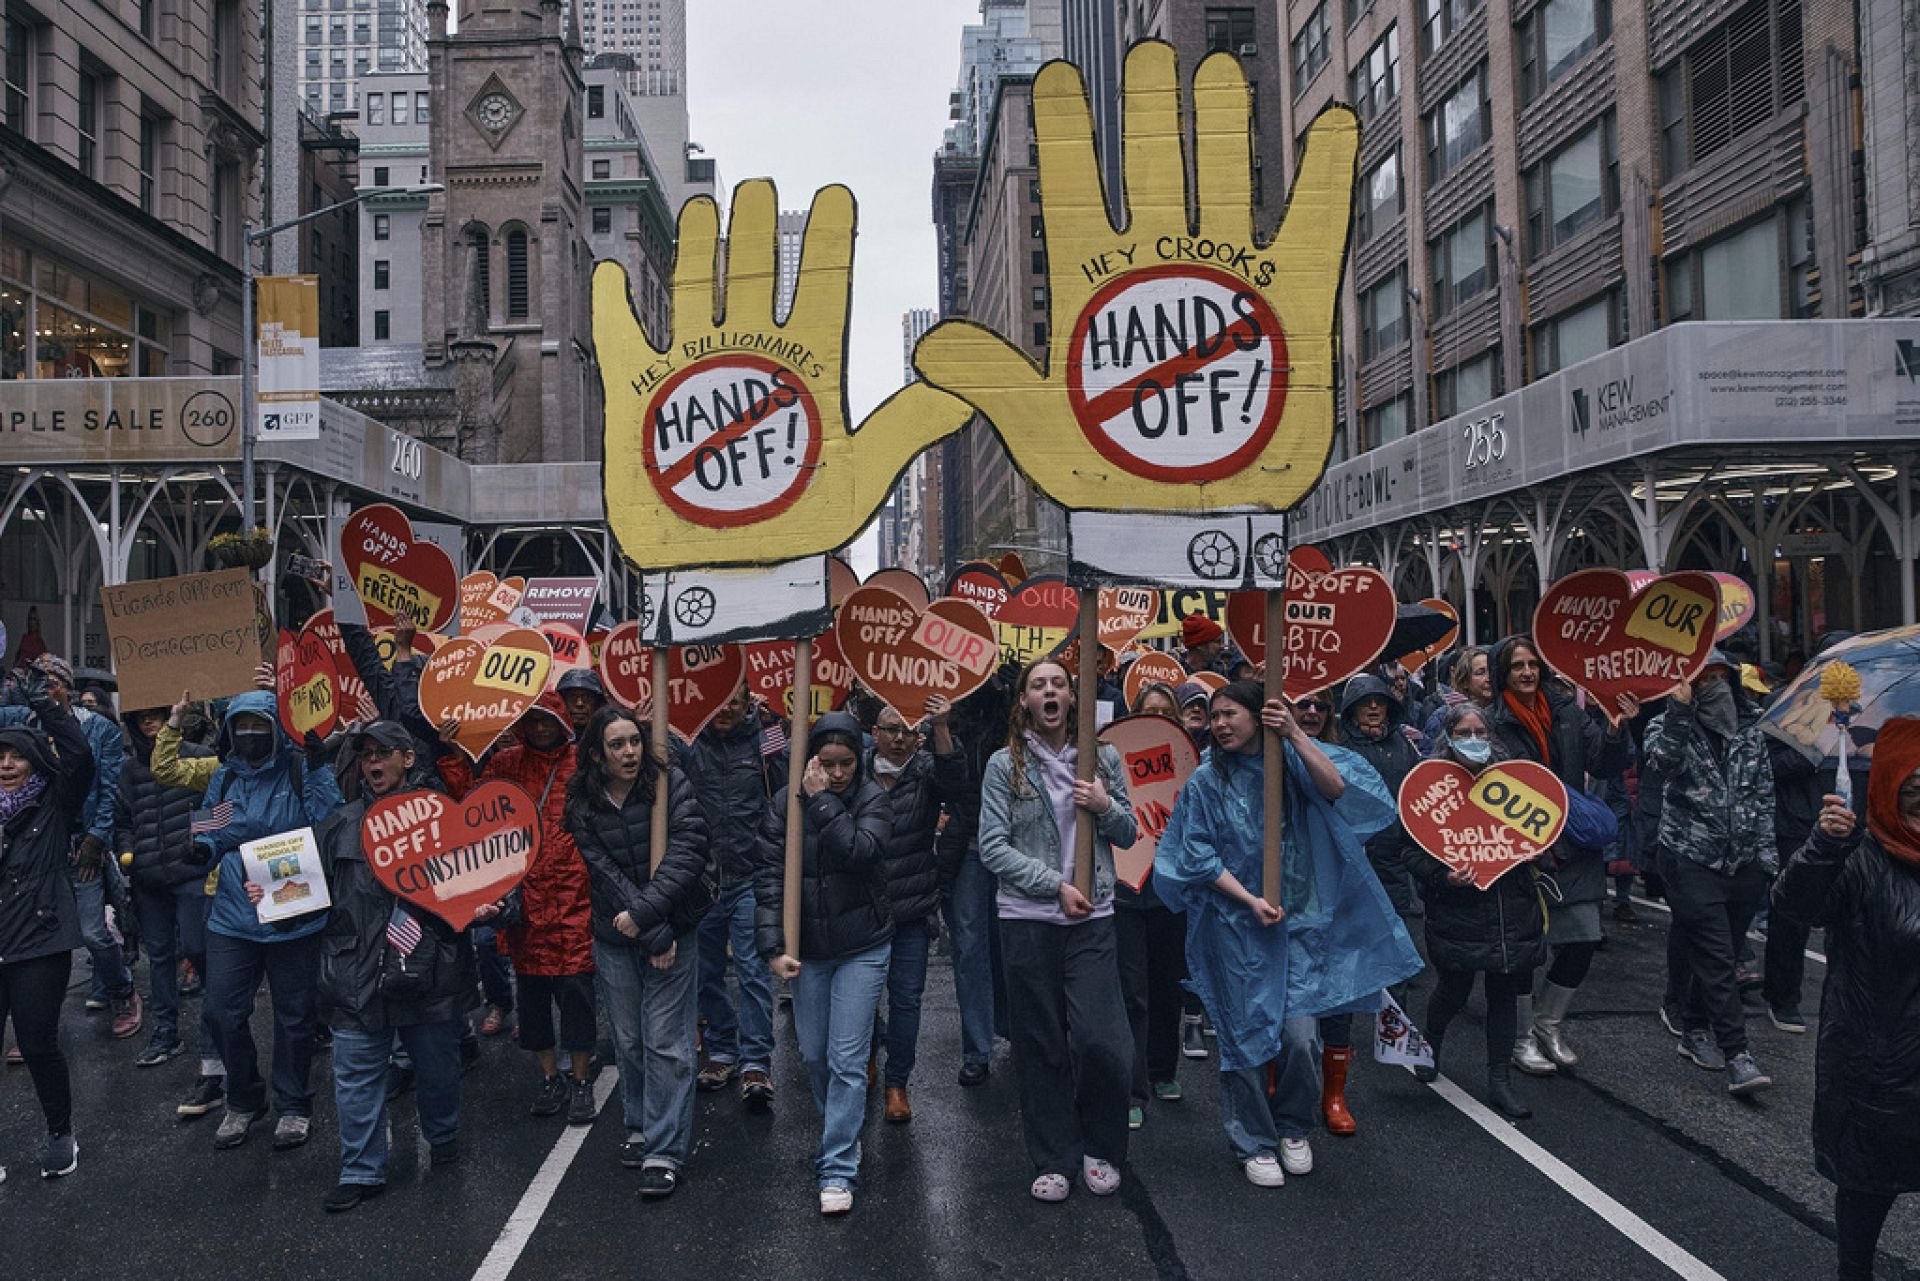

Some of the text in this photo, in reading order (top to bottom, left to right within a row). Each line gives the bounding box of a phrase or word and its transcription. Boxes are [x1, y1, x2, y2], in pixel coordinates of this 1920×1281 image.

[1081, 243, 1136, 284] HEY
[1089, 291, 1263, 370] HANDS
[631, 331, 824, 397] HEY BILLIONAIRES
[655, 366, 800, 451] HANDS
[1132, 358, 1264, 438] OFF!
[1597, 375, 1634, 415] KEW
[84, 408, 164, 430] SALE
[189, 410, 228, 427] 260
[1599, 395, 1671, 432] MANAGEMENT
[391, 434, 421, 480] 260
[693, 412, 799, 491] OFF!
[1463, 411, 1505, 469] 255
[360, 517, 408, 557] HANDS
[363, 538, 398, 565] OFF!
[108, 583, 176, 618] Hands
[378, 573, 419, 600] OUR
[529, 584, 593, 598] REMOVE
[958, 580, 1007, 602] HANDS
[1021, 586, 1079, 609] OUR
[1119, 590, 1149, 610] OUR
[363, 576, 430, 633] FREEDOMS
[851, 605, 914, 628] HANDS
[1286, 603, 1333, 621] OUR
[1553, 595, 1621, 621] HANDS
[1646, 594, 1703, 637] OUR
[860, 627, 906, 646] OFF!
[923, 620, 985, 668] OUR
[1252, 624, 1341, 655] LBTQ
[1561, 619, 1610, 645] OFF!
[429, 643, 476, 672] HANDS
[436, 661, 471, 682] OFF!
[485, 652, 536, 687] OUR
[749, 637, 821, 673] HANS
[868, 650, 961, 689] UNIONS
[1135, 662, 1180, 681] HANDS
[1584, 646, 1690, 680] FREEDOMS
[636, 676, 705, 705] DTA
[1133, 753, 1175, 779] OUR
[464, 794, 516, 828] OUR
[1410, 773, 1460, 817] HANDS
[1430, 790, 1465, 825] OFF!
[1483, 781, 1551, 838] OUR
[366, 792, 444, 842] HANDS
[374, 820, 441, 868] OFF!
[395, 824, 534, 894] CONSTITUTION
[1443, 841, 1536, 863] SCHOOLS
